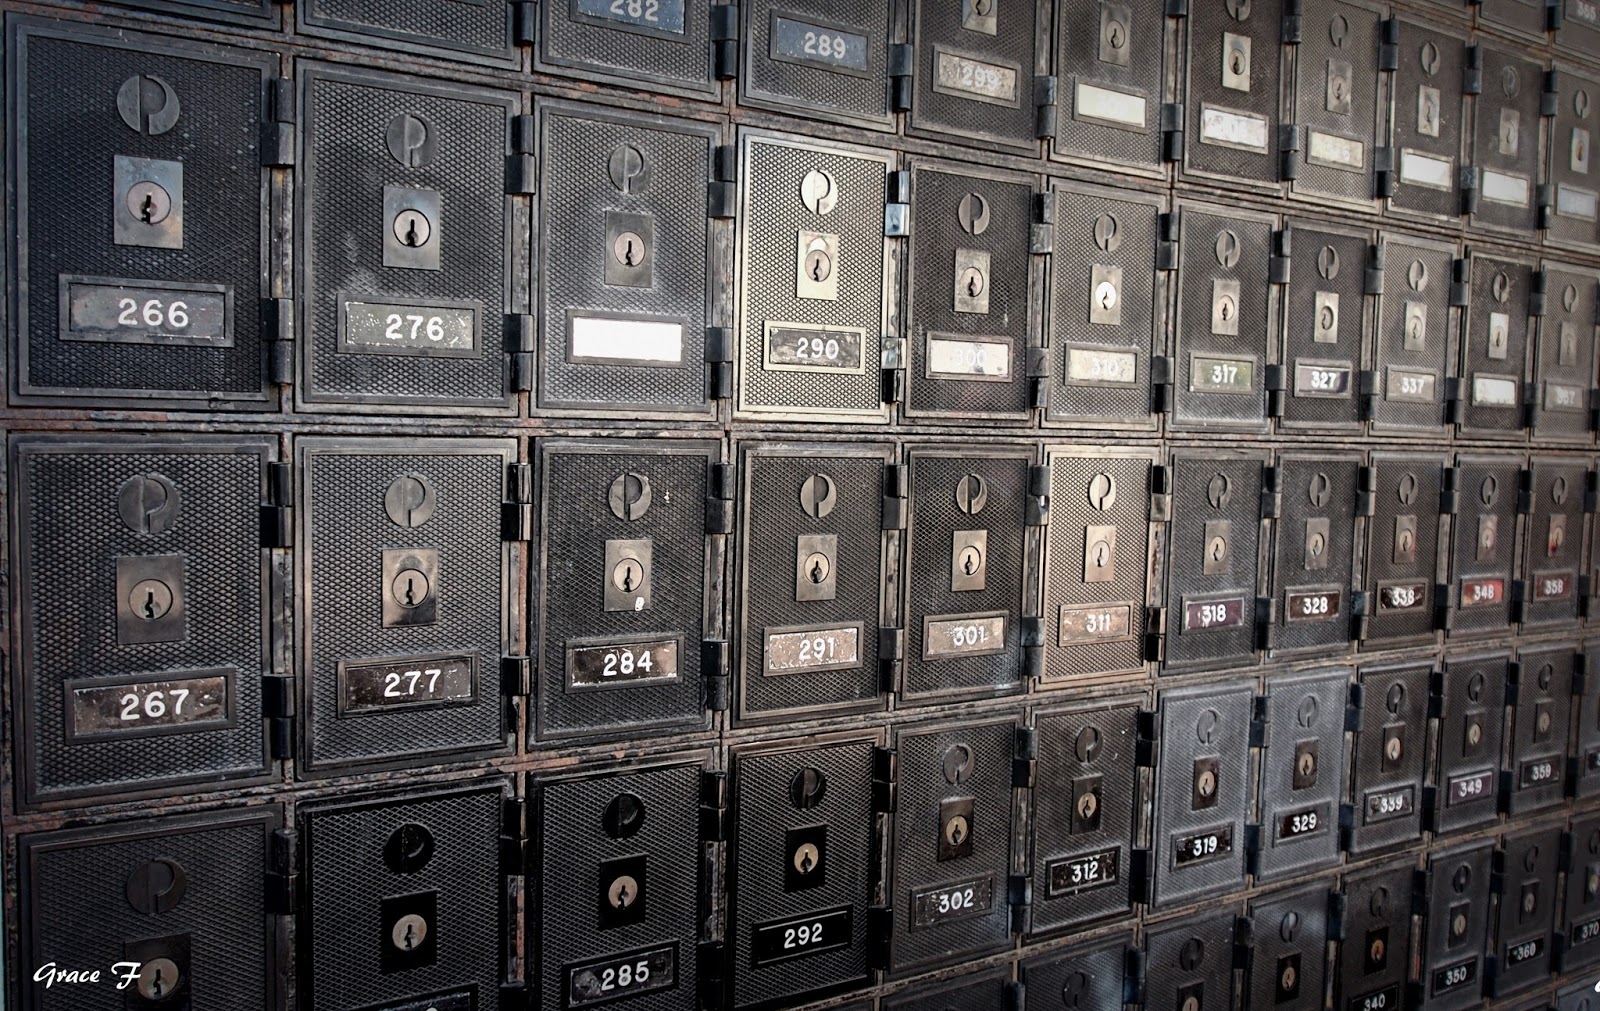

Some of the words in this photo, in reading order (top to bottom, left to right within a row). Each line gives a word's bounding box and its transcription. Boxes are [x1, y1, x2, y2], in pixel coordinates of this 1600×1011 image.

[804, 32, 846, 59] 289
[962, 65, 1000, 90] 299
[118, 299, 189, 327] 266
[386, 314, 445, 341] 276
[797, 338, 839, 360] 290
[1213, 365, 1238, 384] 317
[1311, 371, 1337, 389] 327
[1401, 378, 1425, 394] 337
[1392, 588, 1416, 607] 338
[1474, 585, 1495, 601] 348
[1545, 579, 1564, 596] 358
[1202, 604, 1227, 623] 318
[1303, 596, 1328, 615] 328
[1086, 614, 1111, 633] 311
[953, 626, 986, 646] 301
[799, 637, 836, 661] 291
[603, 651, 653, 676] 284
[384, 669, 441, 697] 277
[121, 689, 190, 721] 267
[1459, 778, 1483, 798] 349
[1292, 813, 1317, 833] 329
[1193, 836, 1218, 857] 319
[1072, 861, 1098, 882] 312
[939, 889, 974, 913] 302
[784, 923, 823, 949] 292
[1582, 921, 1600, 939] 370
[1517, 942, 1536, 961] 360
[602, 961, 650, 991] 285
[1446, 966, 1467, 986] 350
[1364, 993, 1386, 1011] 340
